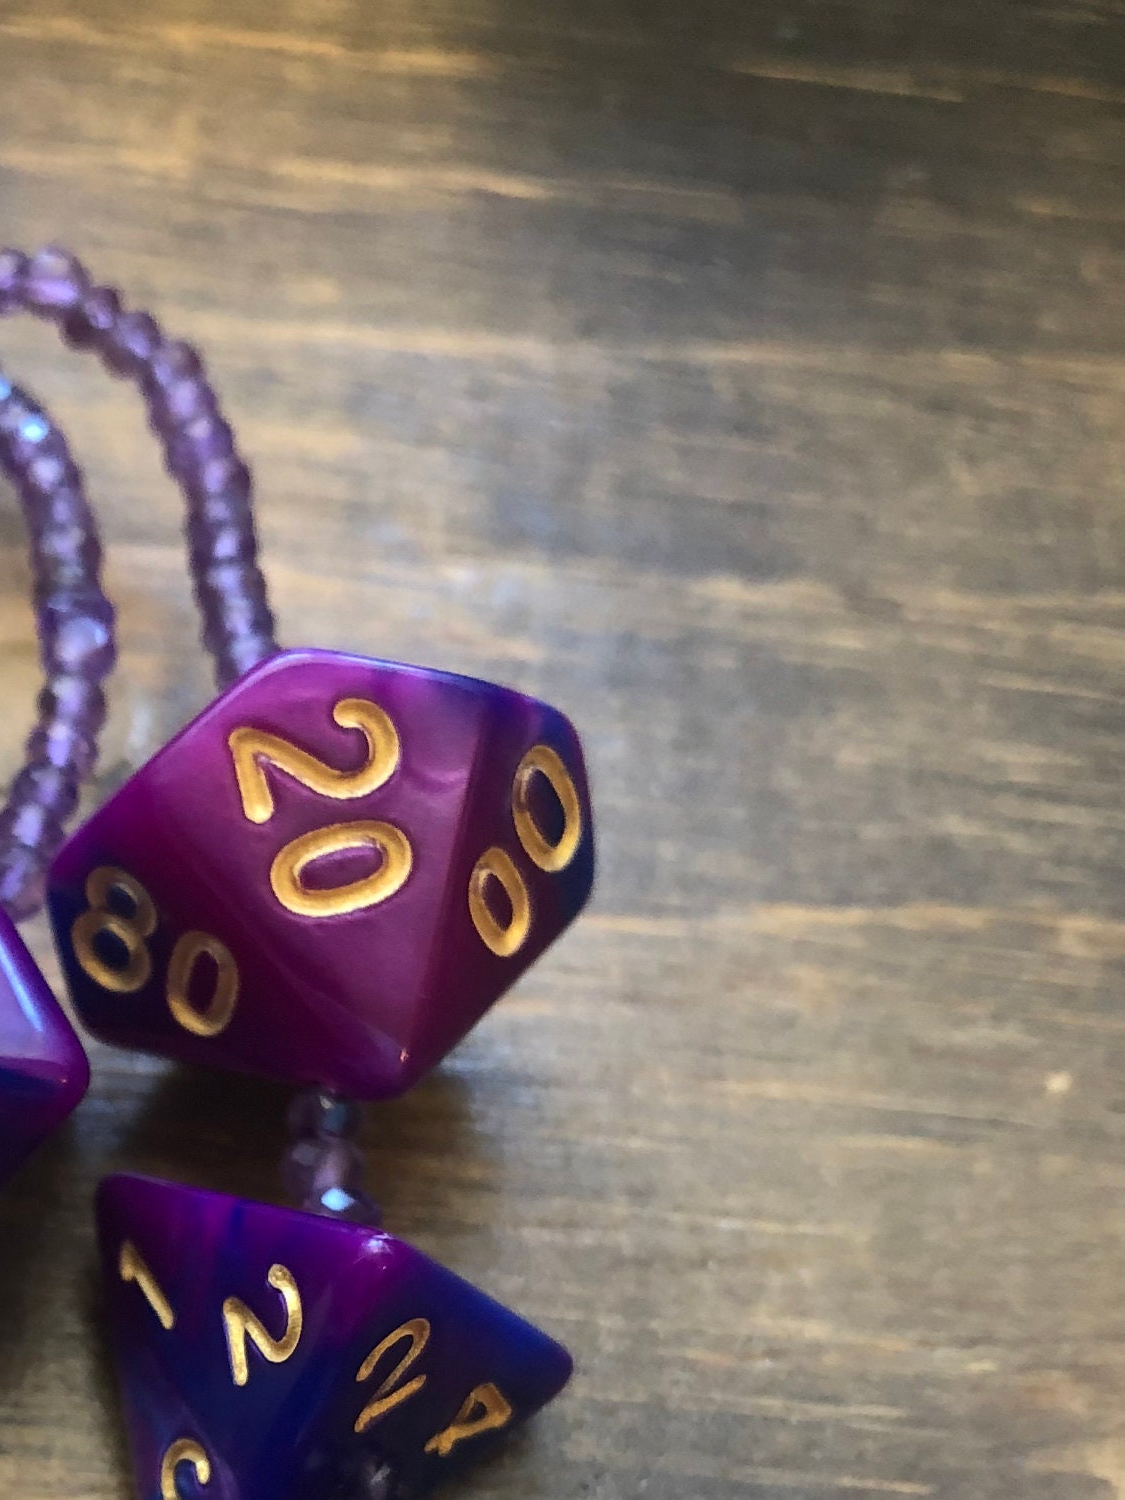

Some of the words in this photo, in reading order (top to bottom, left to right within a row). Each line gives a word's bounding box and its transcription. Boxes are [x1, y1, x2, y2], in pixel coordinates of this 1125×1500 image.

[229, 698, 413, 918] 20
[467, 744, 582, 958] 00
[71, 865, 240, 1037] 80
[118, 1240, 174, 1330] 1
[222, 1263, 303, 1387] 2
[354, 1317, 431, 1433] 2
[424, 1381, 513, 1457] 4
